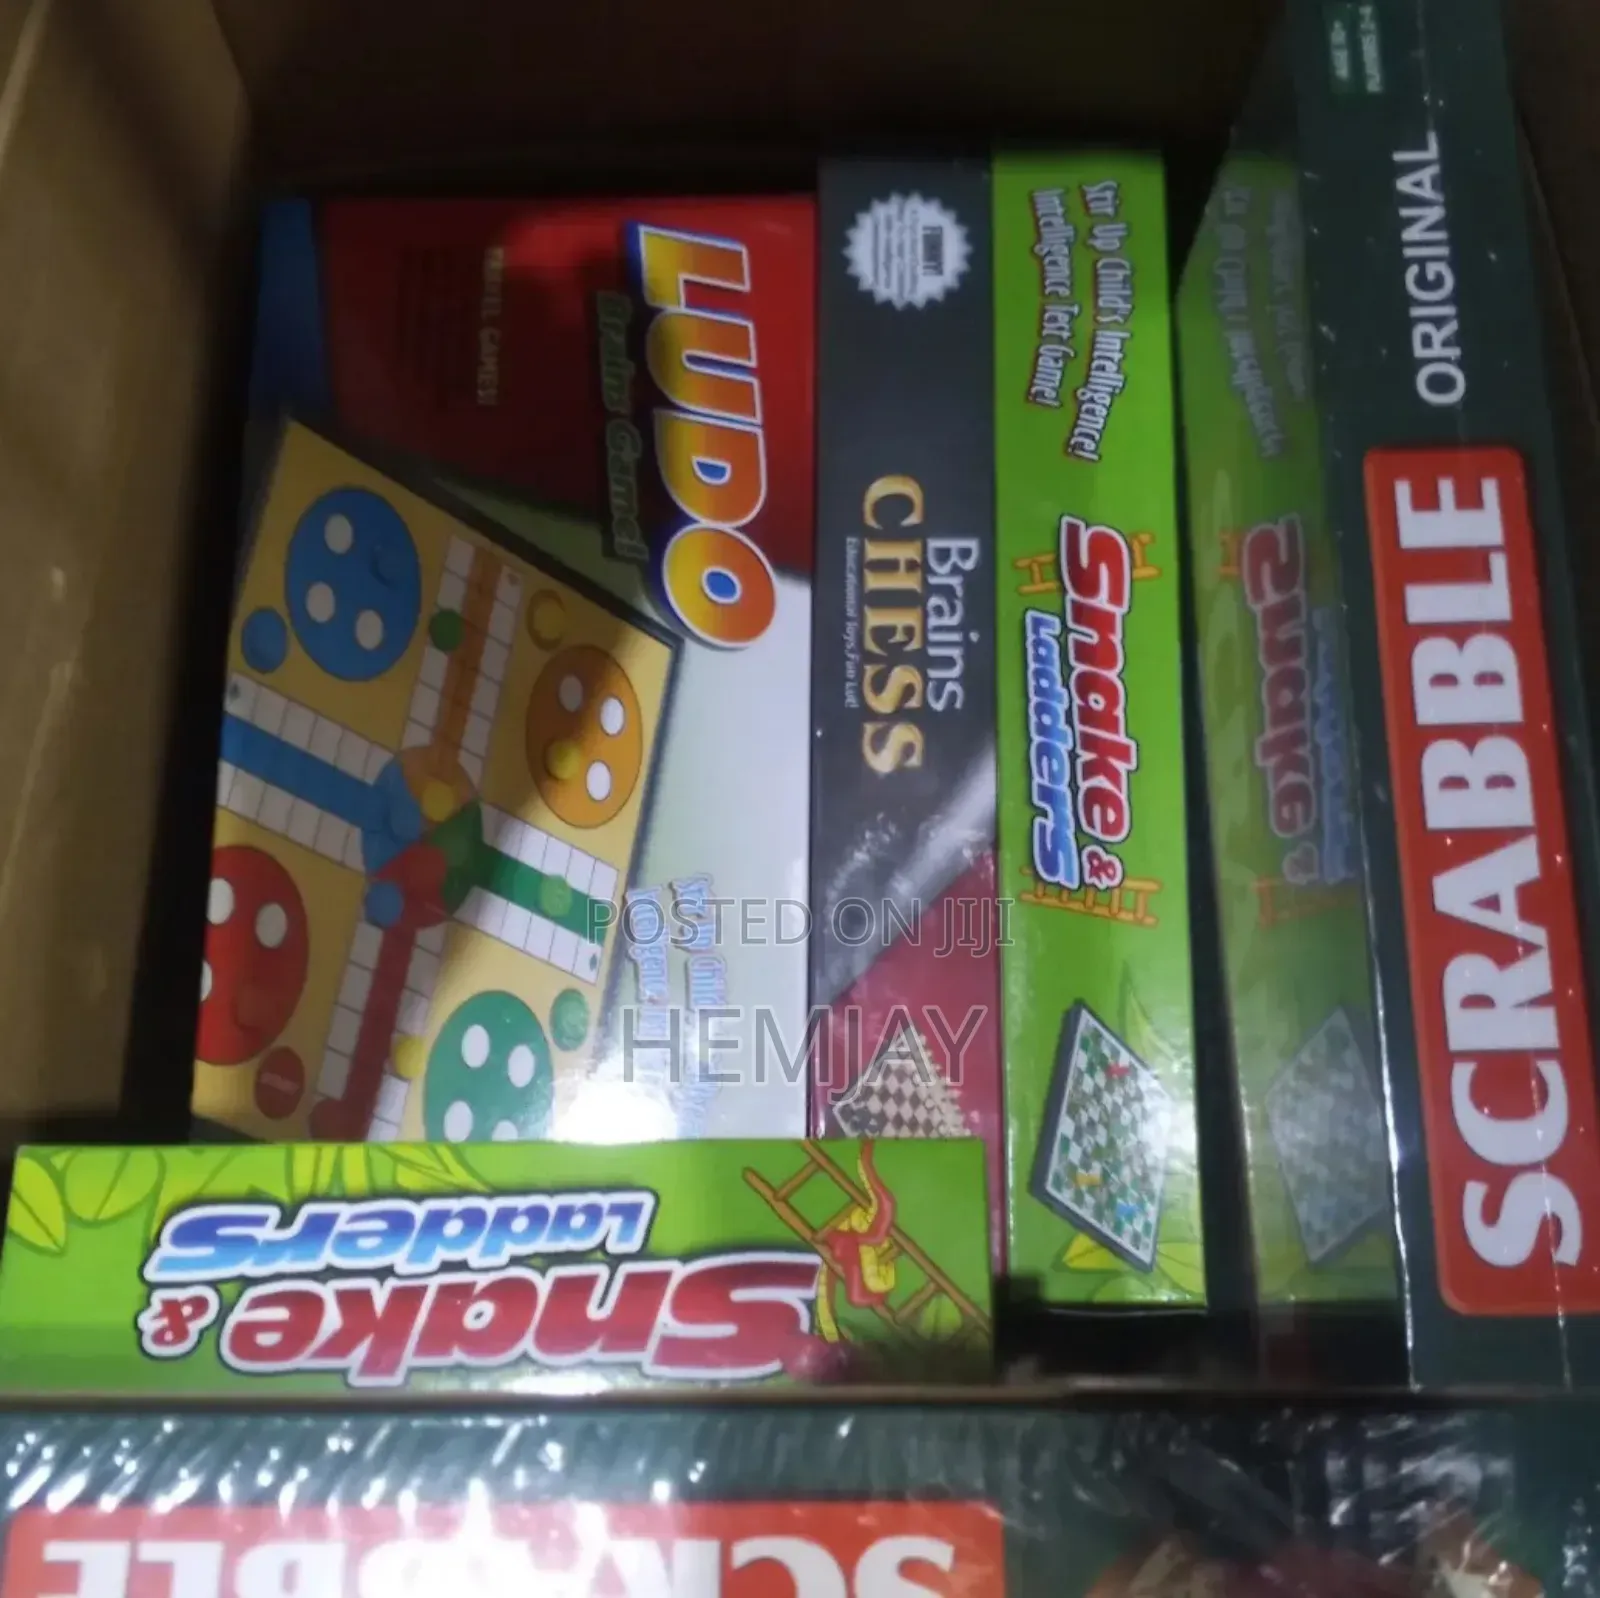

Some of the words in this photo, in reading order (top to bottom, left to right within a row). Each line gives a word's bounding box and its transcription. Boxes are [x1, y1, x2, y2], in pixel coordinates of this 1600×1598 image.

[1031, 188, 1074, 298] Intelligence
[1081, 181, 1118, 216] Stir
[1087, 222, 1127, 251] Up
[1041, 304, 1079, 340] Test
[1094, 257, 1132, 324] Child's
[1392, 131, 1466, 405] ORIGINAL
[630, 221, 776, 649] LUDO
[1028, 344, 1074, 408] Game!
[1068, 331, 1131, 461] Intelligence!
[862, 474, 924, 774] CHESS
[926, 537, 980, 712] Brains
[1061, 516, 1137, 842] Snake
[1026, 610, 1079, 890] Ladders
[1081, 845, 1122, 889] &
[1395, 477, 1582, 1268] SCRABBLE
[144, 1192, 656, 1282] Ladders
[138, 1284, 217, 1358] &
[221, 1252, 822, 1388] Snake
